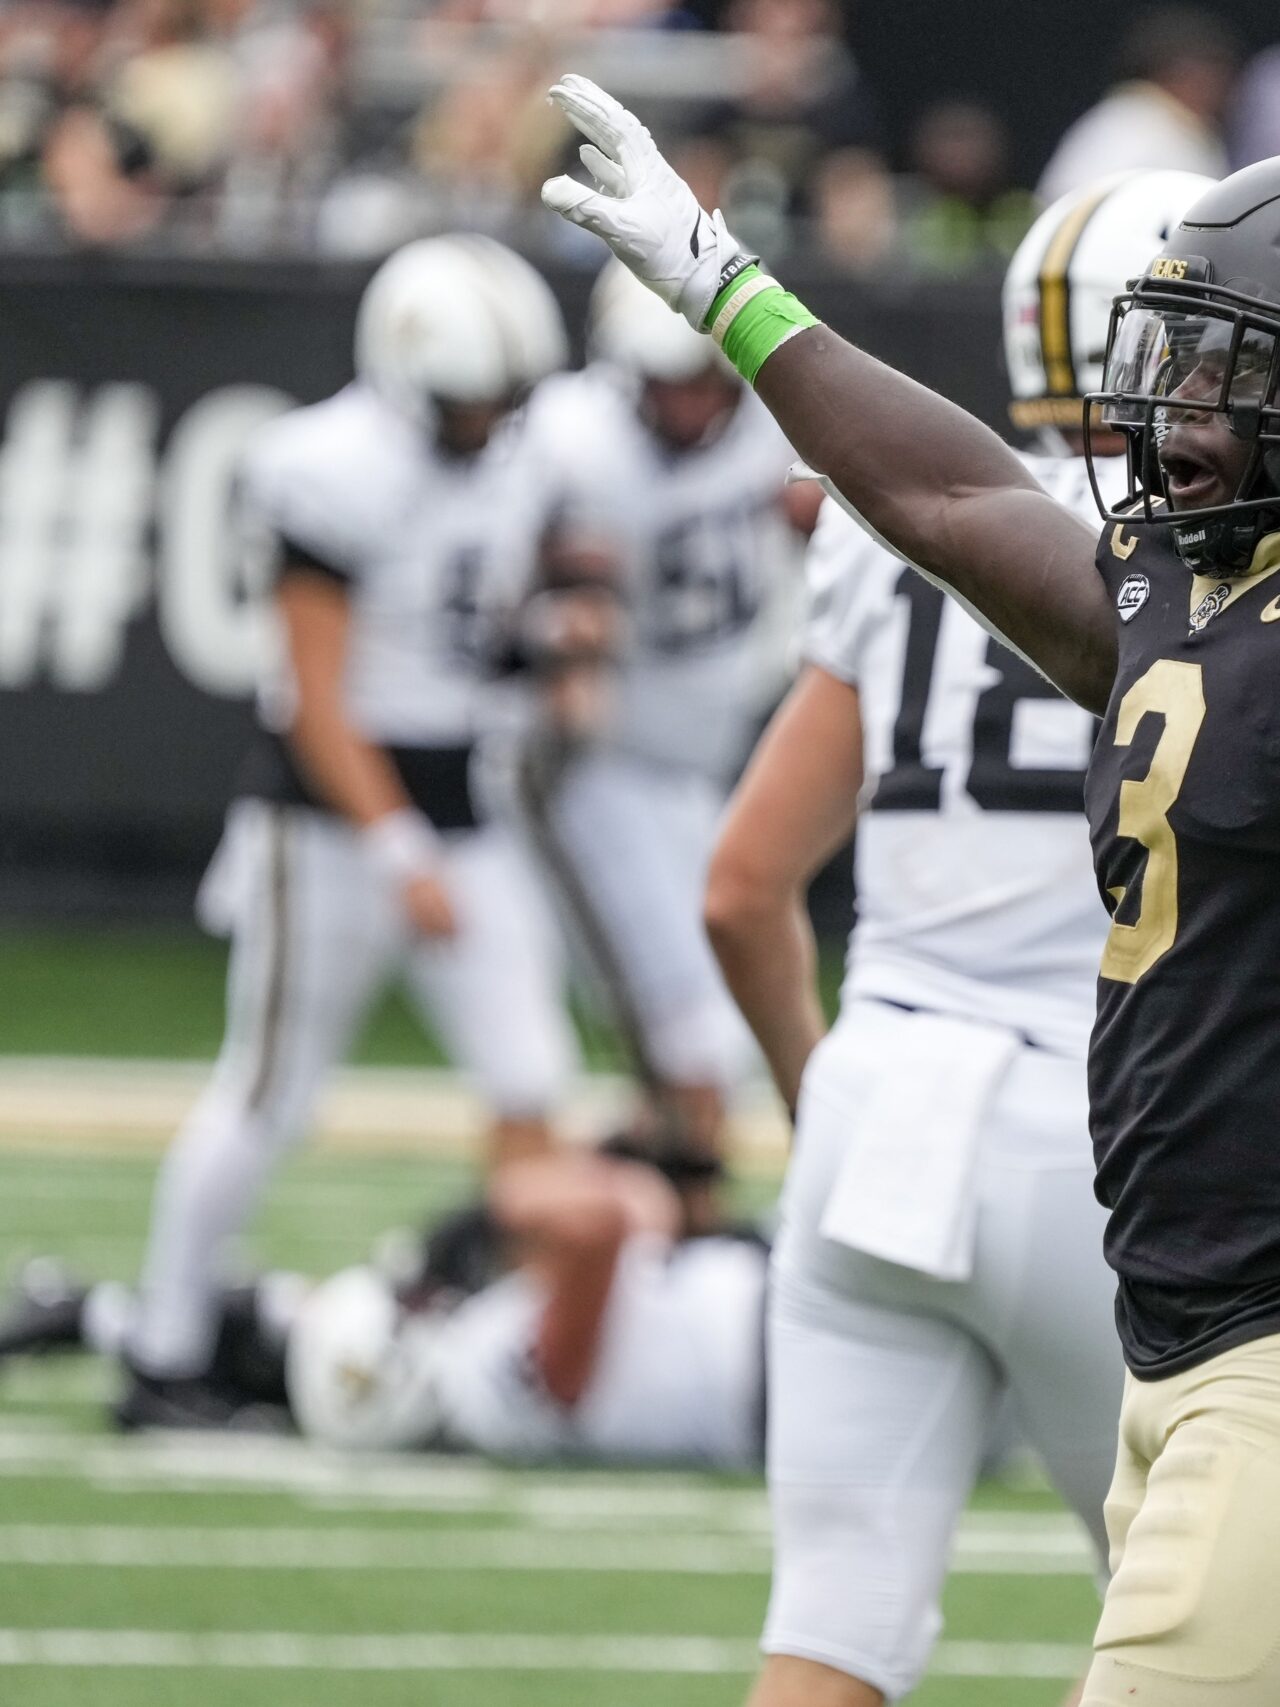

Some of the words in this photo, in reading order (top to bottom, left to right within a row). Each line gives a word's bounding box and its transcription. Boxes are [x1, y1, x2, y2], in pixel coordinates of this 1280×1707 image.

[1178, 530, 1206, 546] Riddell
[1120, 586, 1147, 604] ACC
[1100, 658, 1206, 984] 3
